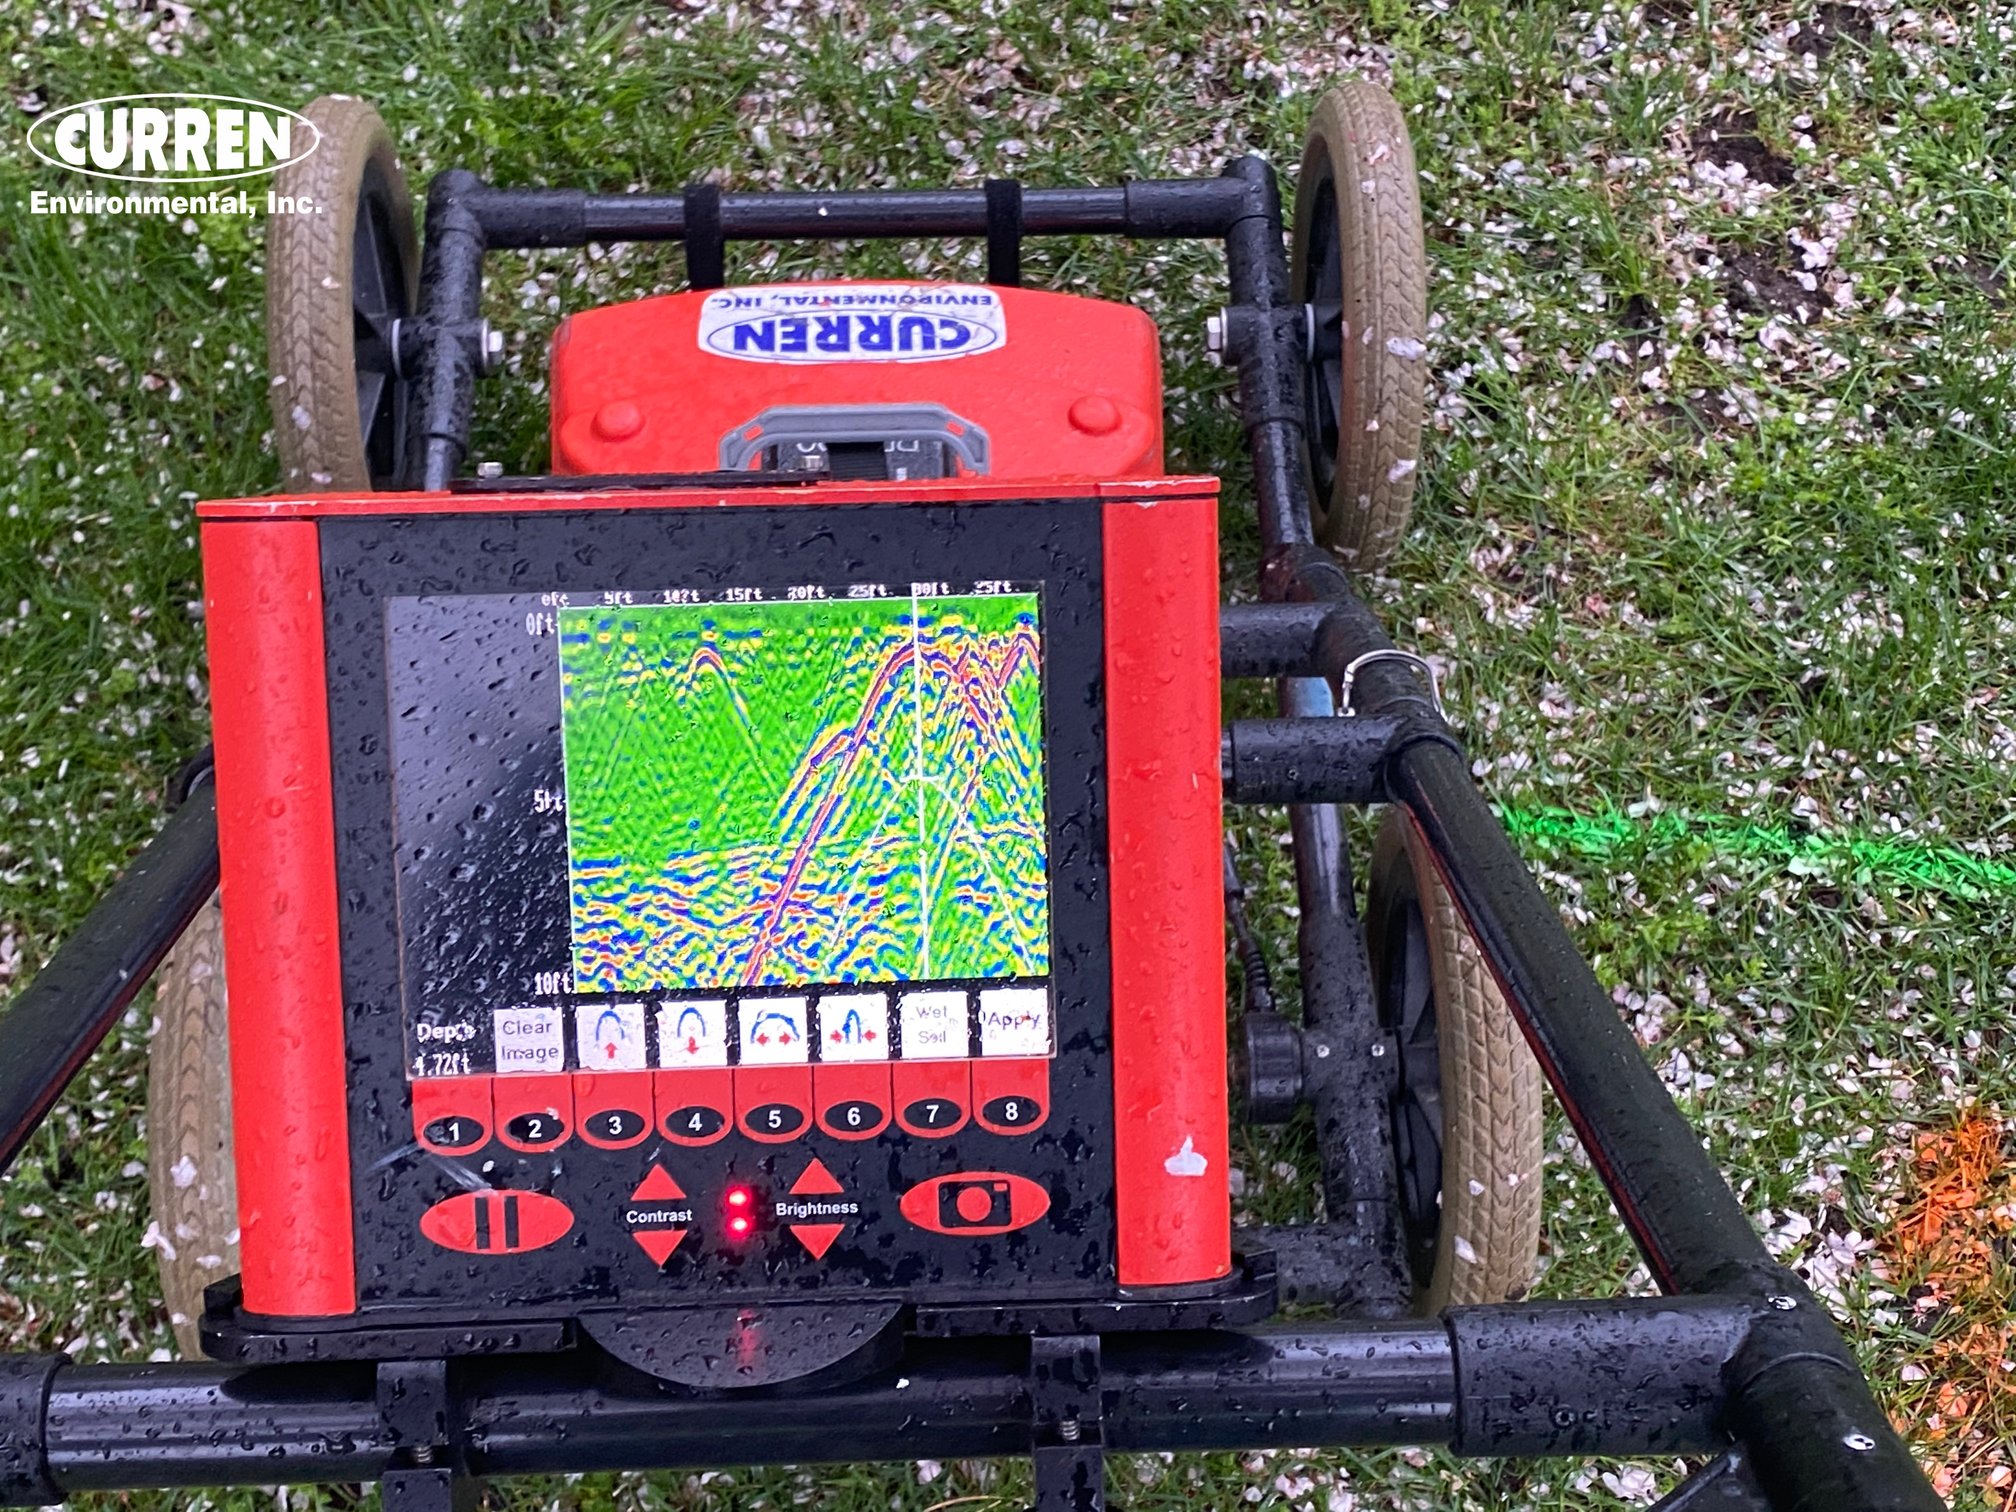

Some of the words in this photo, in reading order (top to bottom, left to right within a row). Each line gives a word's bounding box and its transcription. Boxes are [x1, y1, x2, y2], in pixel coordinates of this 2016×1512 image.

[710, 298, 762, 308] INC.
[772, 293, 992, 307] ENVIRONMENTAL,
[733, 315, 971, 353] CURREN
[848, 584, 888, 598] 25ft
[534, 971, 571, 995] 10ft
[916, 1005, 948, 1019] Wet
[417, 1022, 476, 1043] Dep
[503, 1020, 552, 1035] Clear
[502, 1046, 559, 1063] Image
[449, 1123, 459, 1141] 1
[528, 1119, 542, 1138] 2
[609, 1116, 622, 1135] 3
[688, 1113, 702, 1131] 4
[768, 1110, 781, 1129] 5
[847, 1107, 861, 1126] 6
[926, 1105, 939, 1123] 7
[1005, 1102, 1019, 1121] 8
[776, 1200, 859, 1217] Brightness
[626, 1210, 693, 1225] Contrast
